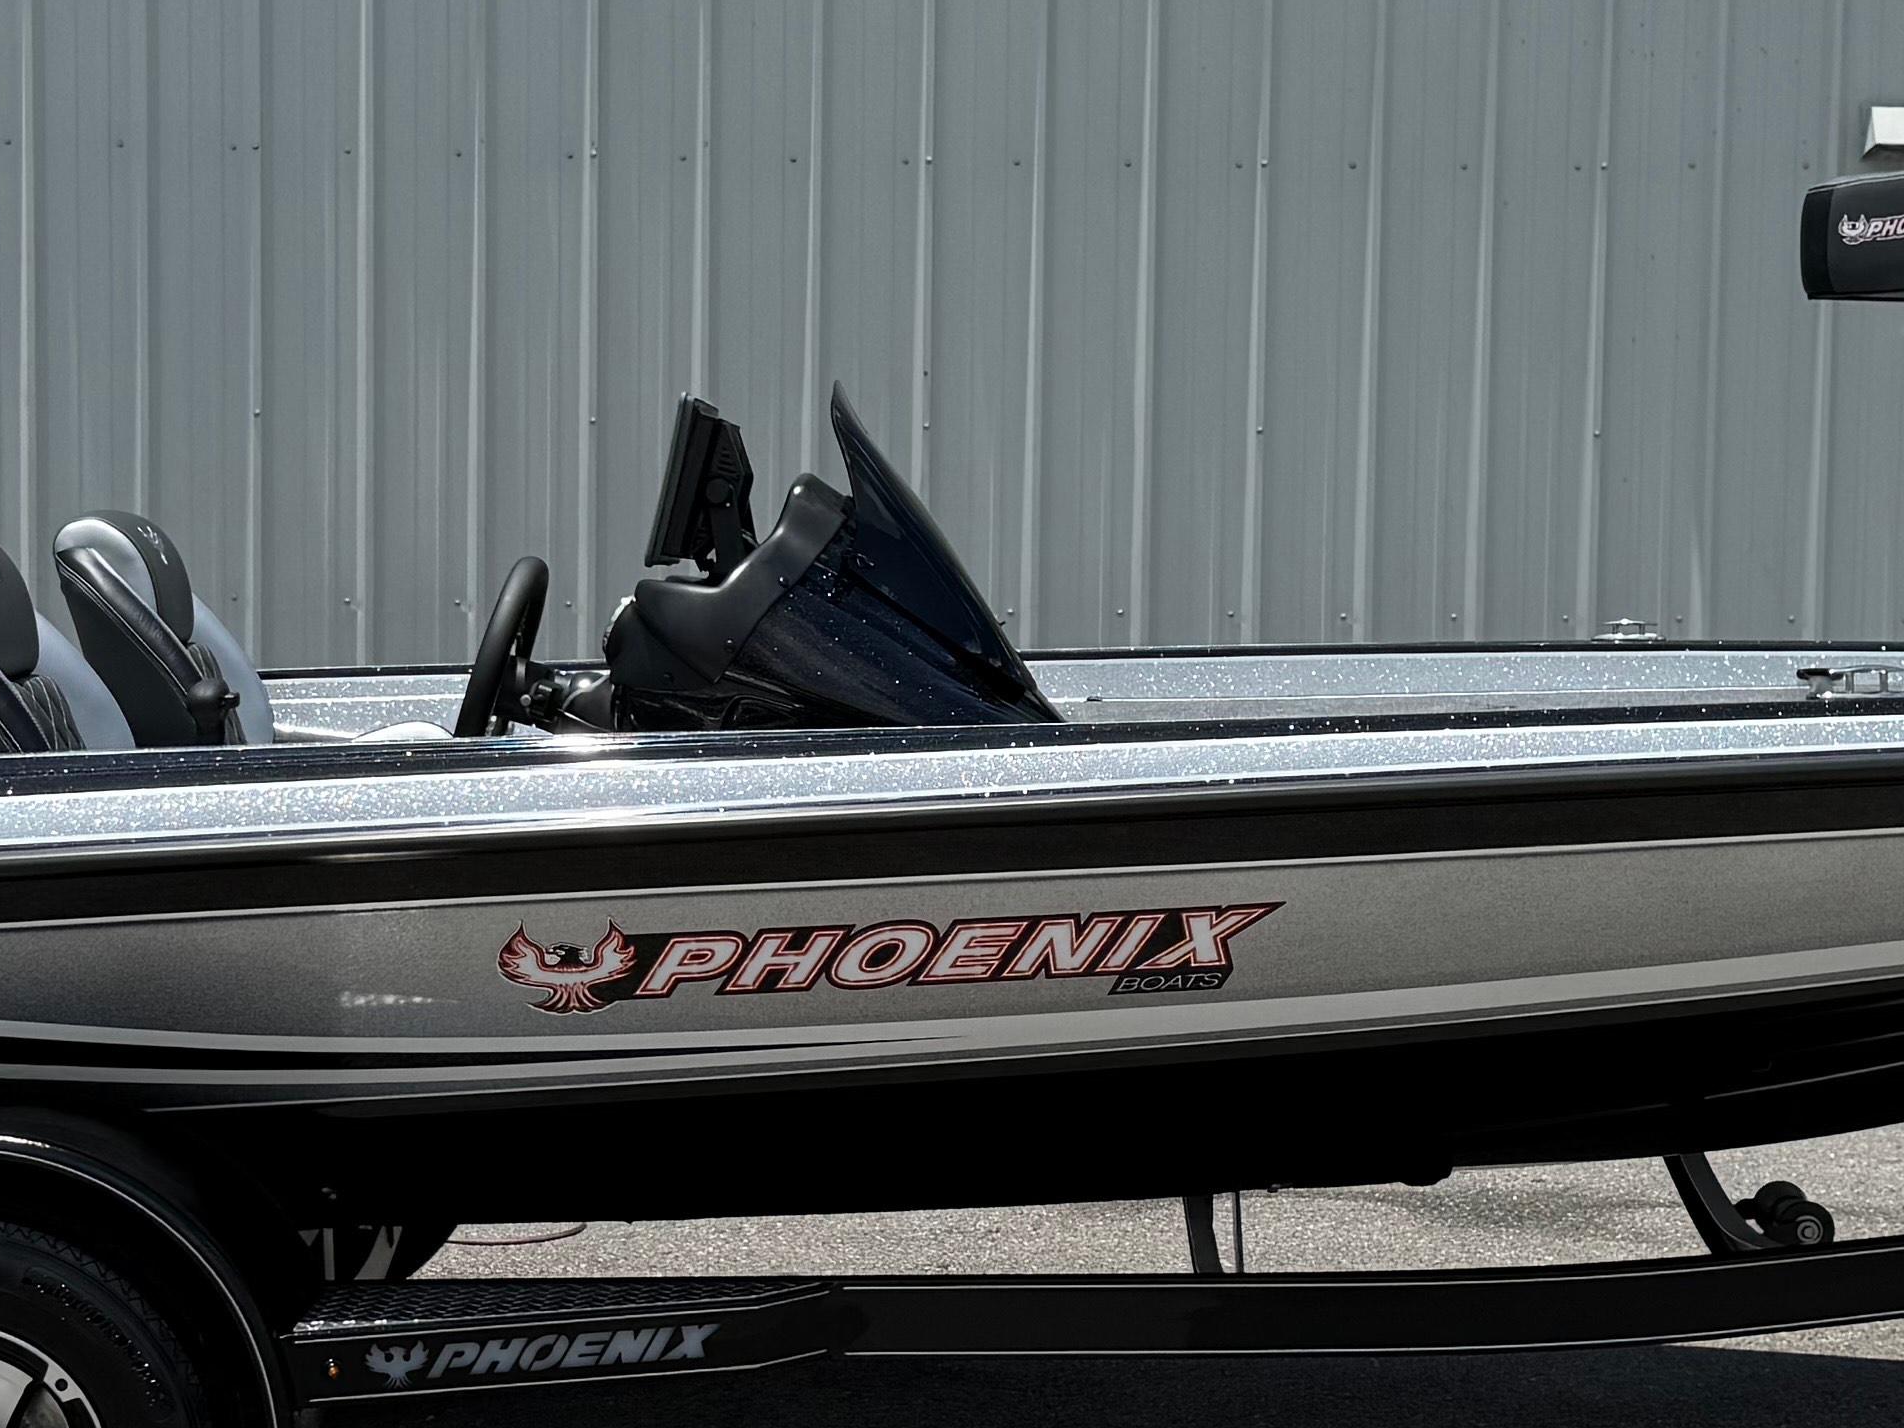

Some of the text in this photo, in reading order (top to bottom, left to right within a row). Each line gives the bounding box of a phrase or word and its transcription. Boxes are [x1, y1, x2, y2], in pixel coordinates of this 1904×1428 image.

[636, 903, 1282, 993] PHOENIX
[1115, 972, 1222, 992] BOATS
[427, 1322, 723, 1379] PHOENIX
